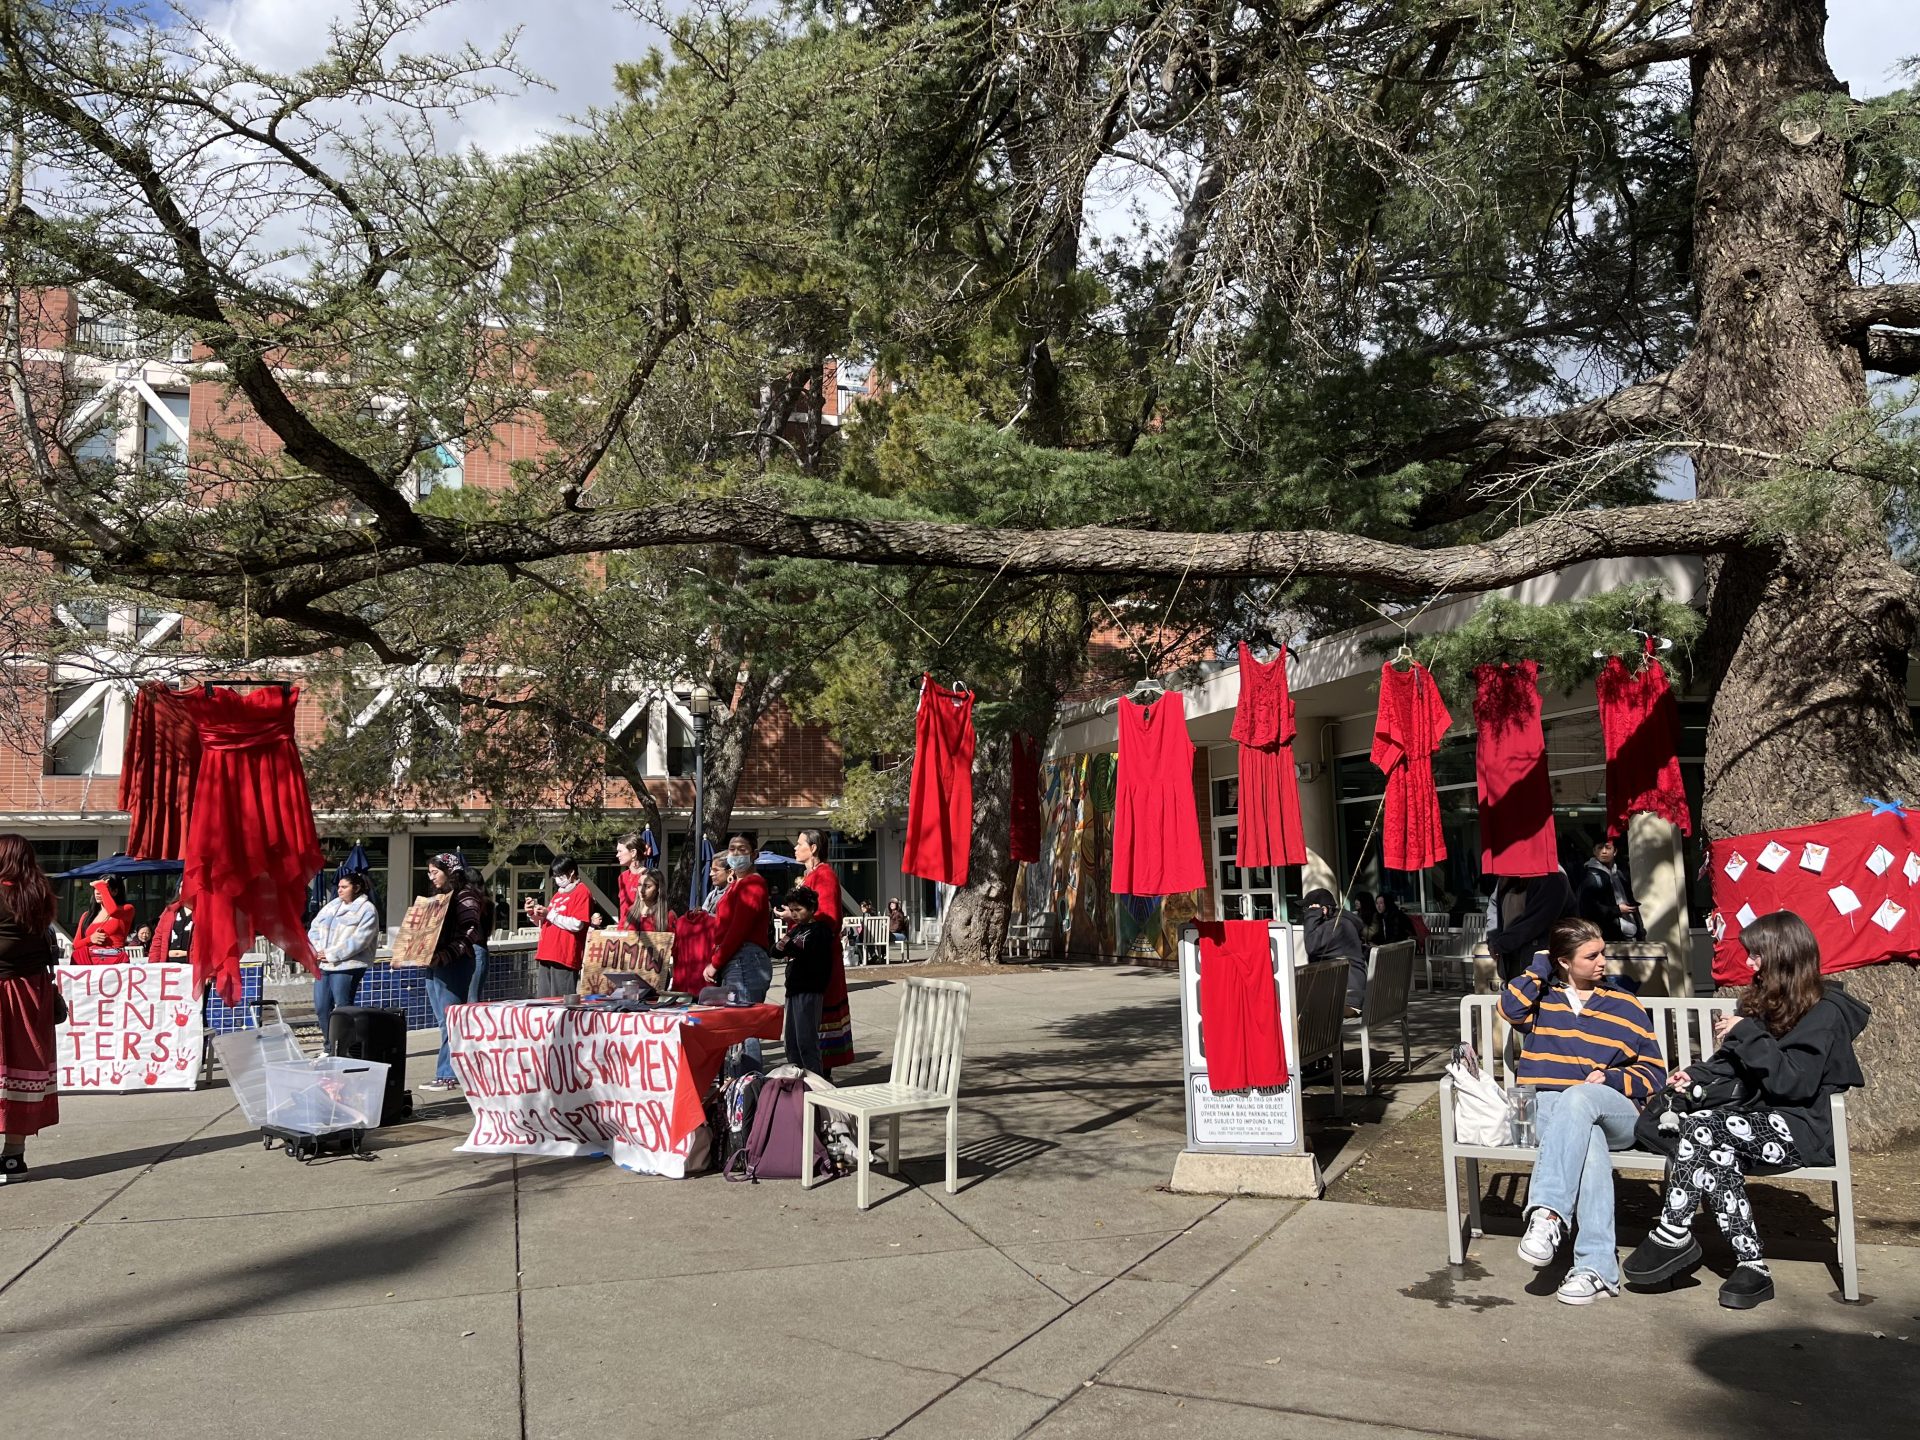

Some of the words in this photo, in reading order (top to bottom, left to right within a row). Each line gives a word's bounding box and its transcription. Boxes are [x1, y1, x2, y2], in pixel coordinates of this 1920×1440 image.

[588, 938, 665, 974] #MMIW
[57, 967, 183, 1001] MORE
[444, 1006, 546, 1041] MISSING
[62, 1066, 101, 1087] IW
[451, 1043, 594, 1097] INDIGENOUS
[591, 1039, 681, 1092] WOMEN
[1195, 1084, 1208, 1094] NO
[1251, 1084, 1291, 1094] PARKING
[474, 1106, 538, 1145] GIRLS
